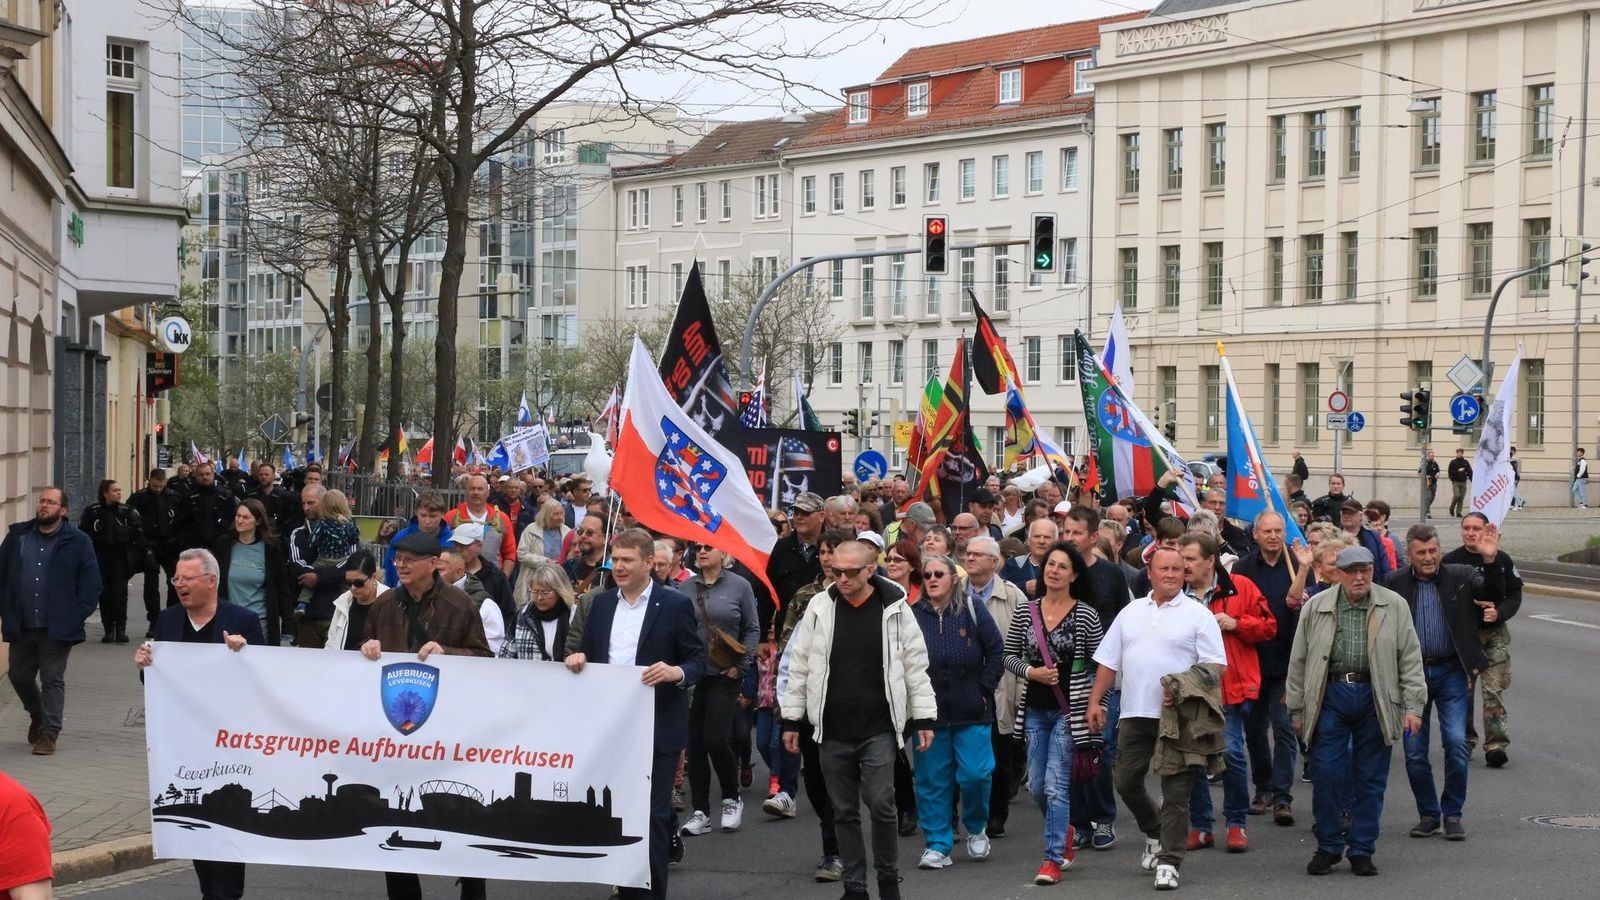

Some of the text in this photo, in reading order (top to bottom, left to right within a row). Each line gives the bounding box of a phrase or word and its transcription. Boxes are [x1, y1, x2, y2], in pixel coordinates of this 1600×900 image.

[682, 320, 711, 367] Ami
[671, 356, 693, 389] go
[1079, 347, 1099, 391] Heim
[747, 444, 768, 465] mi
[387, 669, 435, 682] AUFBRUCH
[388, 678, 432, 689] LEVERKUSEN
[215, 728, 575, 769] Ratsgruppe Aufbruch Leverkusen
[174, 759, 253, 781] Leverkusen
